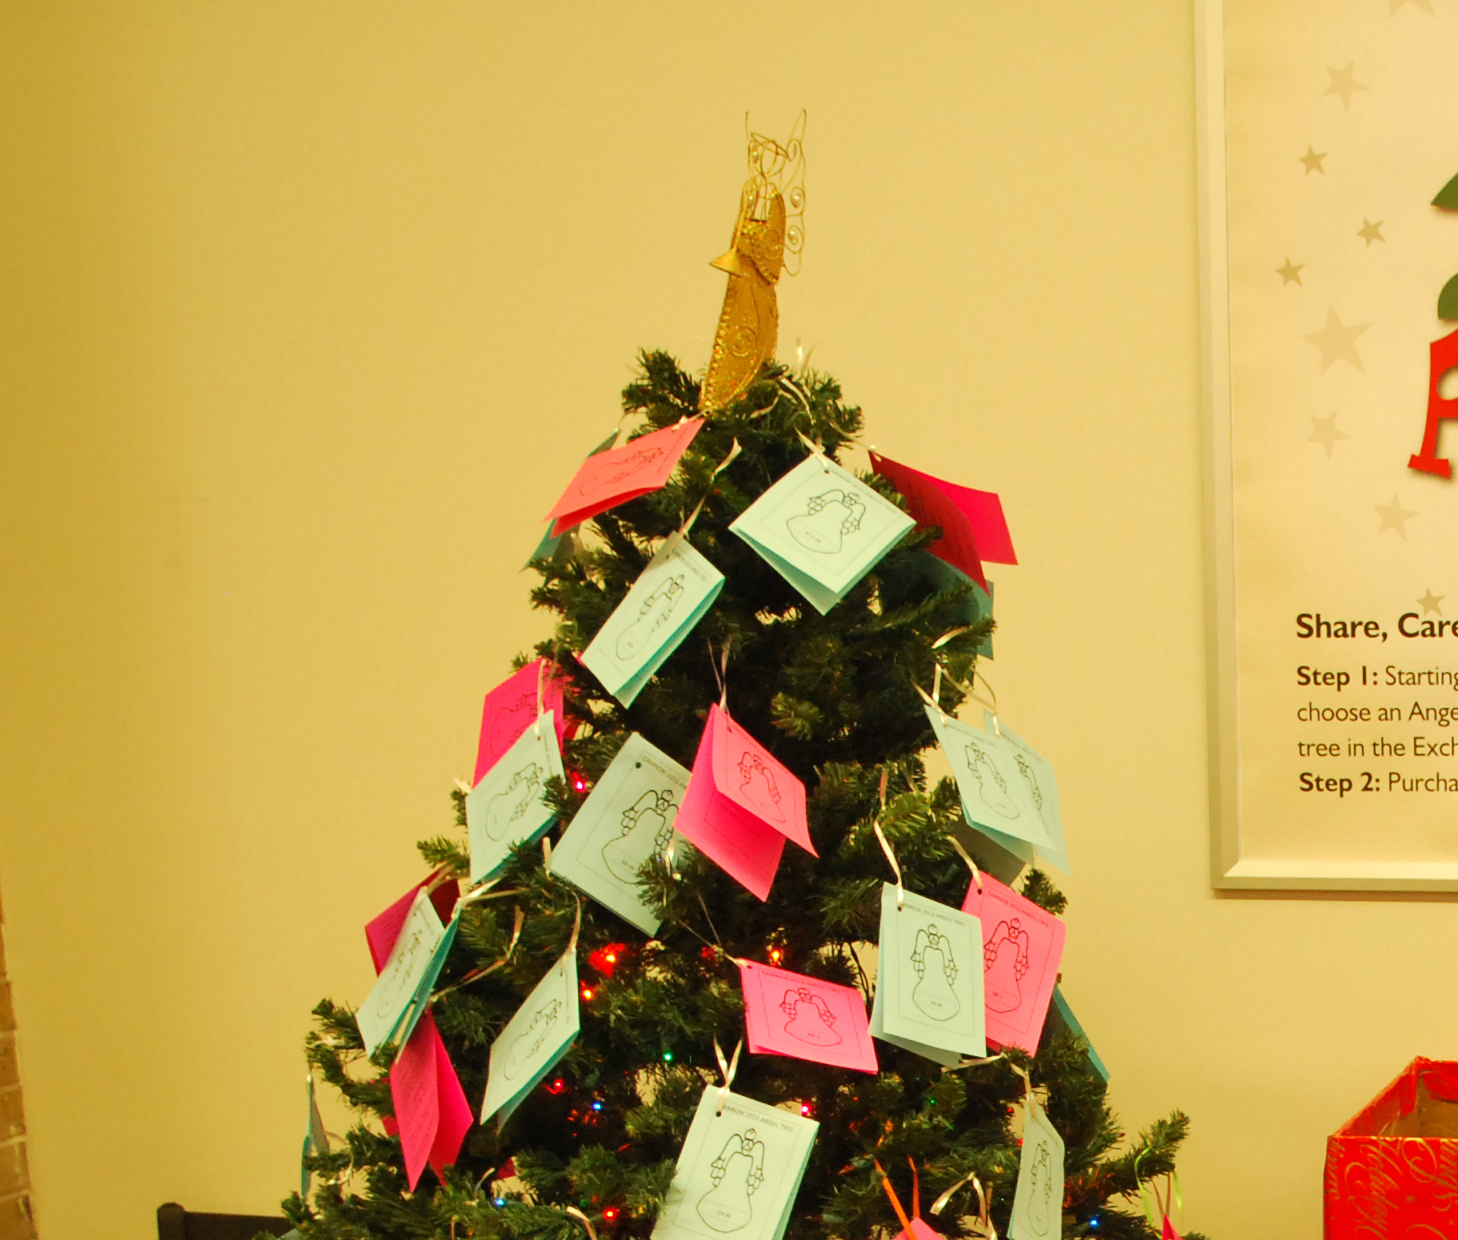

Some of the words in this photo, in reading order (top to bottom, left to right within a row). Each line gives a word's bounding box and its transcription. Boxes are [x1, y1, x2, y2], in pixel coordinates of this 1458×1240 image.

[1296, 613, 1388, 642] Share,
[1297, 666, 1350, 691] Step
[1362, 666, 1378, 686] 1:
[1297, 702, 1370, 721] choose
[1378, 707, 1400, 720] an
[1298, 741, 1340, 757] tree
[1348, 739, 1364, 756] in
[1372, 738, 1406, 756] the
[1299, 772, 1352, 798] Step
[1360, 772, 1380, 792] 2:
[759, 1116, 779, 1127] ANGEL
[779, 1123, 794, 1133] TREE
